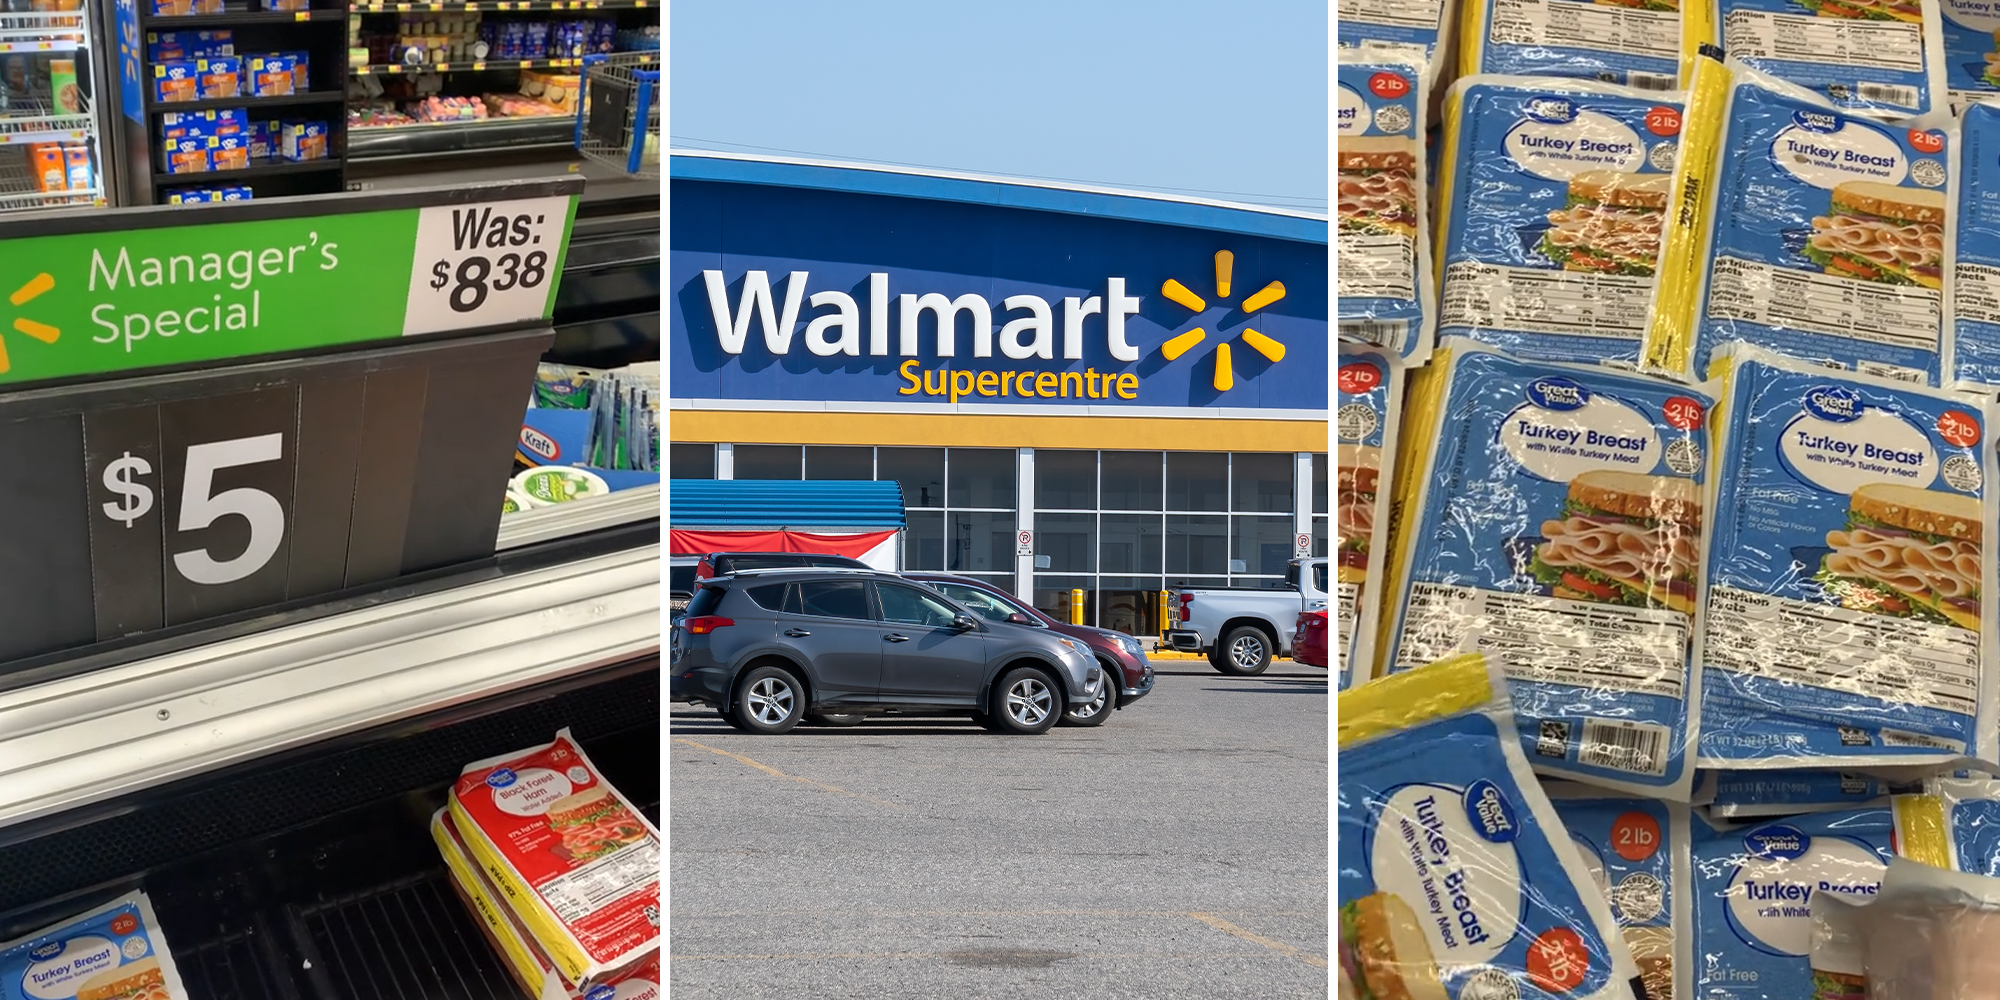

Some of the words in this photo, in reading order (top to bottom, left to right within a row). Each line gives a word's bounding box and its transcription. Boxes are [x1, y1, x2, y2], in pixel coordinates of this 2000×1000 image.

[1754, 49, 1766, 57] 25
[1376, 79, 1386, 90] 2
[1388, 79, 1404, 90] lb
[1651, 116, 1662, 127] 2
[1664, 117, 1679, 128] lb
[1800, 111, 1836, 124] Great
[1519, 134, 1574, 152] Turkey
[1580, 139, 1633, 155] Breast
[1914, 133, 1924, 143] 2
[1925, 135, 1940, 146] lb
[1548, 152, 1573, 161] White
[1575, 154, 1602, 164] Turkey
[1787, 140, 1839, 160] Turkey
[1844, 150, 1896, 168] Breast
[1813, 159, 1837, 169] White
[1839, 163, 1867, 175] Turkey
[1867, 169, 1890, 178] Meat
[453, 207, 545, 250] Was:
[88, 232, 338, 291] Manager's
[92, 291, 260, 352] Special
[703, 270, 1140, 362] Walmart
[1742, 311, 1757, 320] 25
[899, 359, 1138, 404] Supercentre
[1340, 370, 1352, 380] 2
[1355, 371, 1374, 383] lb
[1535, 382, 1578, 397] Great
[1811, 392, 1854, 409] Great
[1671, 404, 1681, 418] 2
[1684, 406, 1699, 420] lb
[1519, 420, 1581, 446] Turkey
[1586, 430, 1648, 451] Breast
[1959, 422, 1975, 438] lb
[524, 432, 551, 455] Kraft
[1798, 432, 1859, 457] Turkey
[1864, 443, 1924, 466] Breast
[1526, 442, 1547, 453] with
[1579, 448, 1612, 462] Turkey
[1613, 453, 1640, 464] Meat
[1806, 453, 1827, 463] with
[1828, 456, 1856, 468] White
[1858, 461, 1889, 475] Turkey
[1891, 467, 1918, 478] Meat
[1762, 507, 1779, 516] MSG
[1757, 523, 1781, 533] Colors
[1762, 517, 1789, 528] Artificial
[1790, 522, 1816, 533] Flavors
[1711, 587, 1769, 607] Nutrition
[1485, 607, 1506, 615] Total
[1573, 618, 1586, 626] 0%
[1589, 620, 1610, 628] Total
[1926, 661, 1936, 669] 0g
[1914, 669, 1936, 679] Added
[1937, 674, 1961, 684] Sugars
[1717, 737, 1731, 745] WT
[1732, 738, 1744, 746] 32
[500, 784, 526, 800] Black
[526, 773, 555, 789] Forest
[523, 788, 547, 801] Ham
[1475, 798, 1497, 834] Value
[1482, 787, 1512, 832] Great
[1619, 827, 1631, 844] 2
[1634, 827, 1652, 844] lb
[1763, 840, 1800, 851] Value
[1400, 818, 1415, 843] with
[1422, 877, 1443, 916] Turkey
[1436, 916, 1459, 950] Meat
[1744, 881, 1812, 905] Turkey
[1443, 868, 1490, 946] Breast
[115, 921, 123, 931] 2
[123, 918, 134, 929] lb
[1541, 939, 1563, 959] 2
[32, 964, 72, 984] Turkey
[74, 949, 111, 969] Breast
[1548, 957, 1570, 981] lb
[1707, 969, 1727, 981] Fat
[1730, 970, 1758, 981] Free
